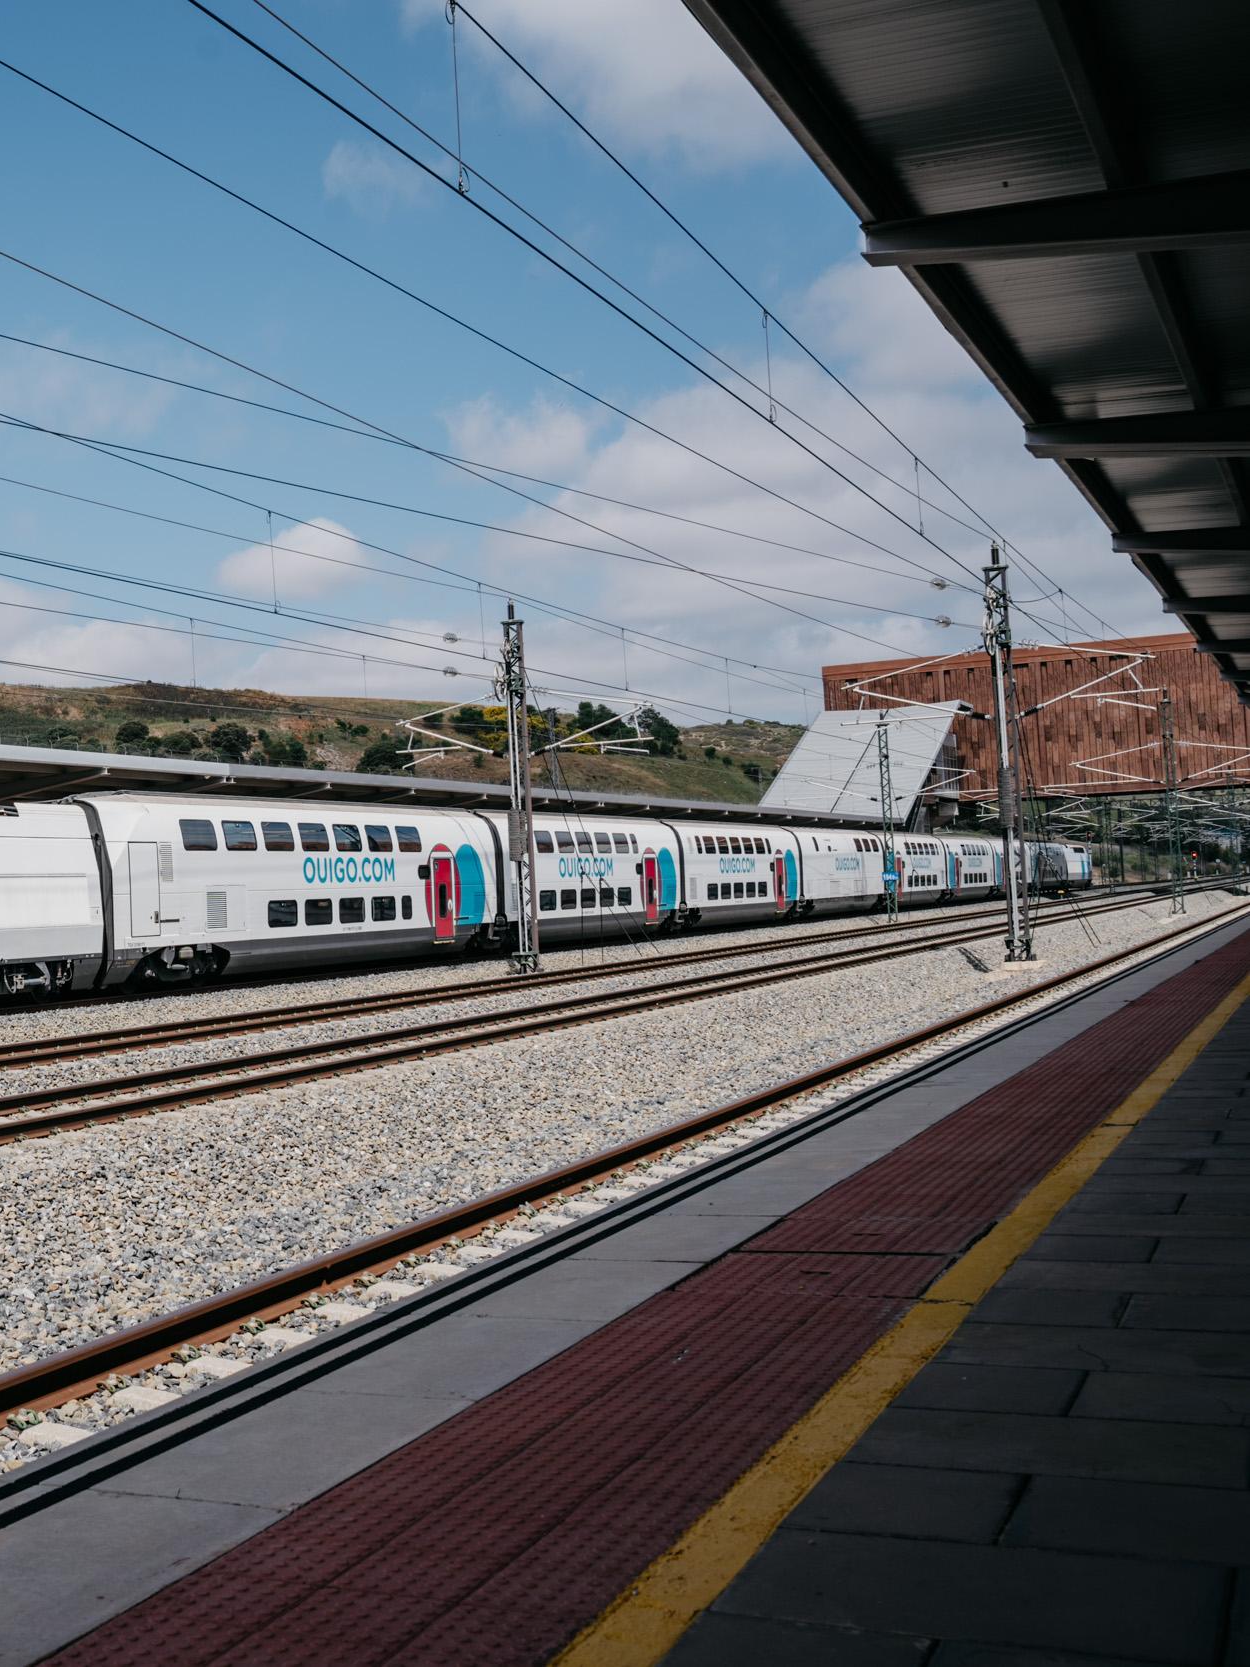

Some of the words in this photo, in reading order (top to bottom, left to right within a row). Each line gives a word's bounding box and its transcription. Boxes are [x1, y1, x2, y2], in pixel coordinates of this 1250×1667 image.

[303, 857, 395, 884] OUIGO.COM
[558, 857, 614, 878] OUIGO.COM
[719, 857, 756, 874] OUIGO.COM
